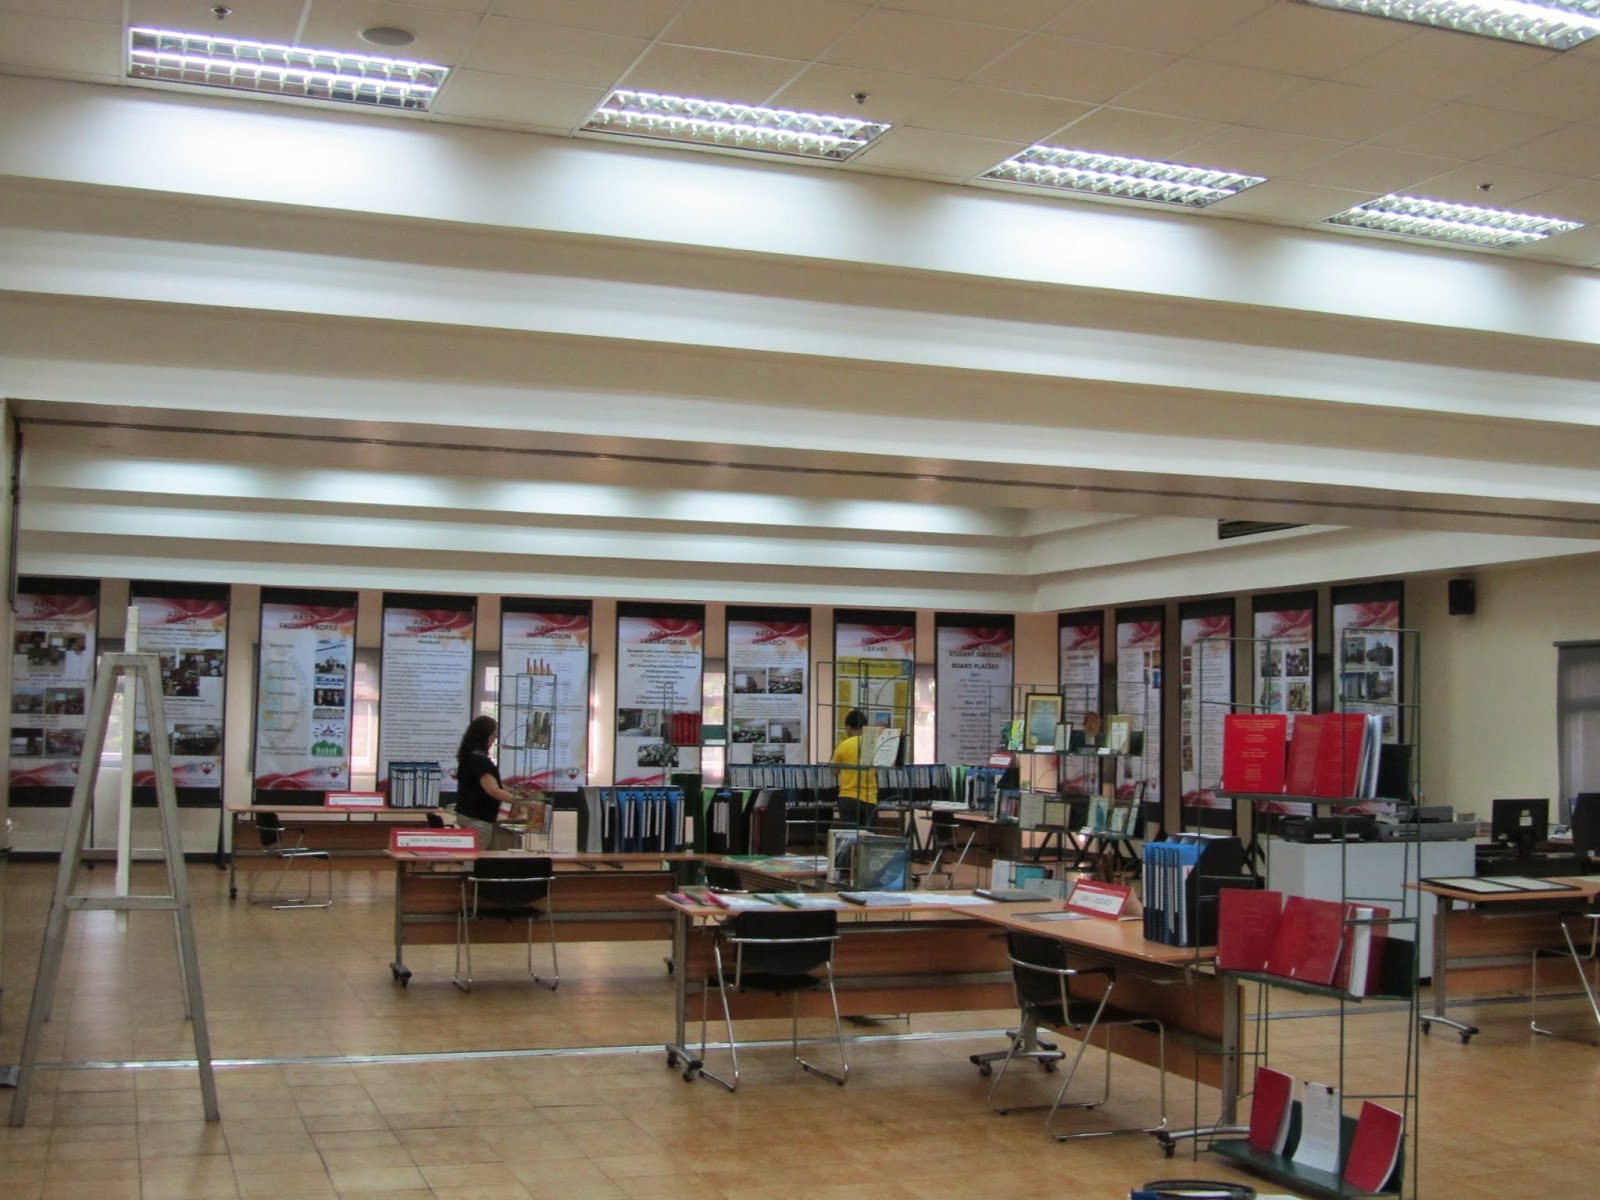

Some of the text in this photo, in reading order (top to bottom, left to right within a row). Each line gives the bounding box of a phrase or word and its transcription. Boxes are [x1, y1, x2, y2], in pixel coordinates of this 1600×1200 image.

[279, 622, 339, 632] FACULTY PROFILE
[405, 625, 452, 633] INSTRTION
[640, 638, 687, 646] LABORATORIES
